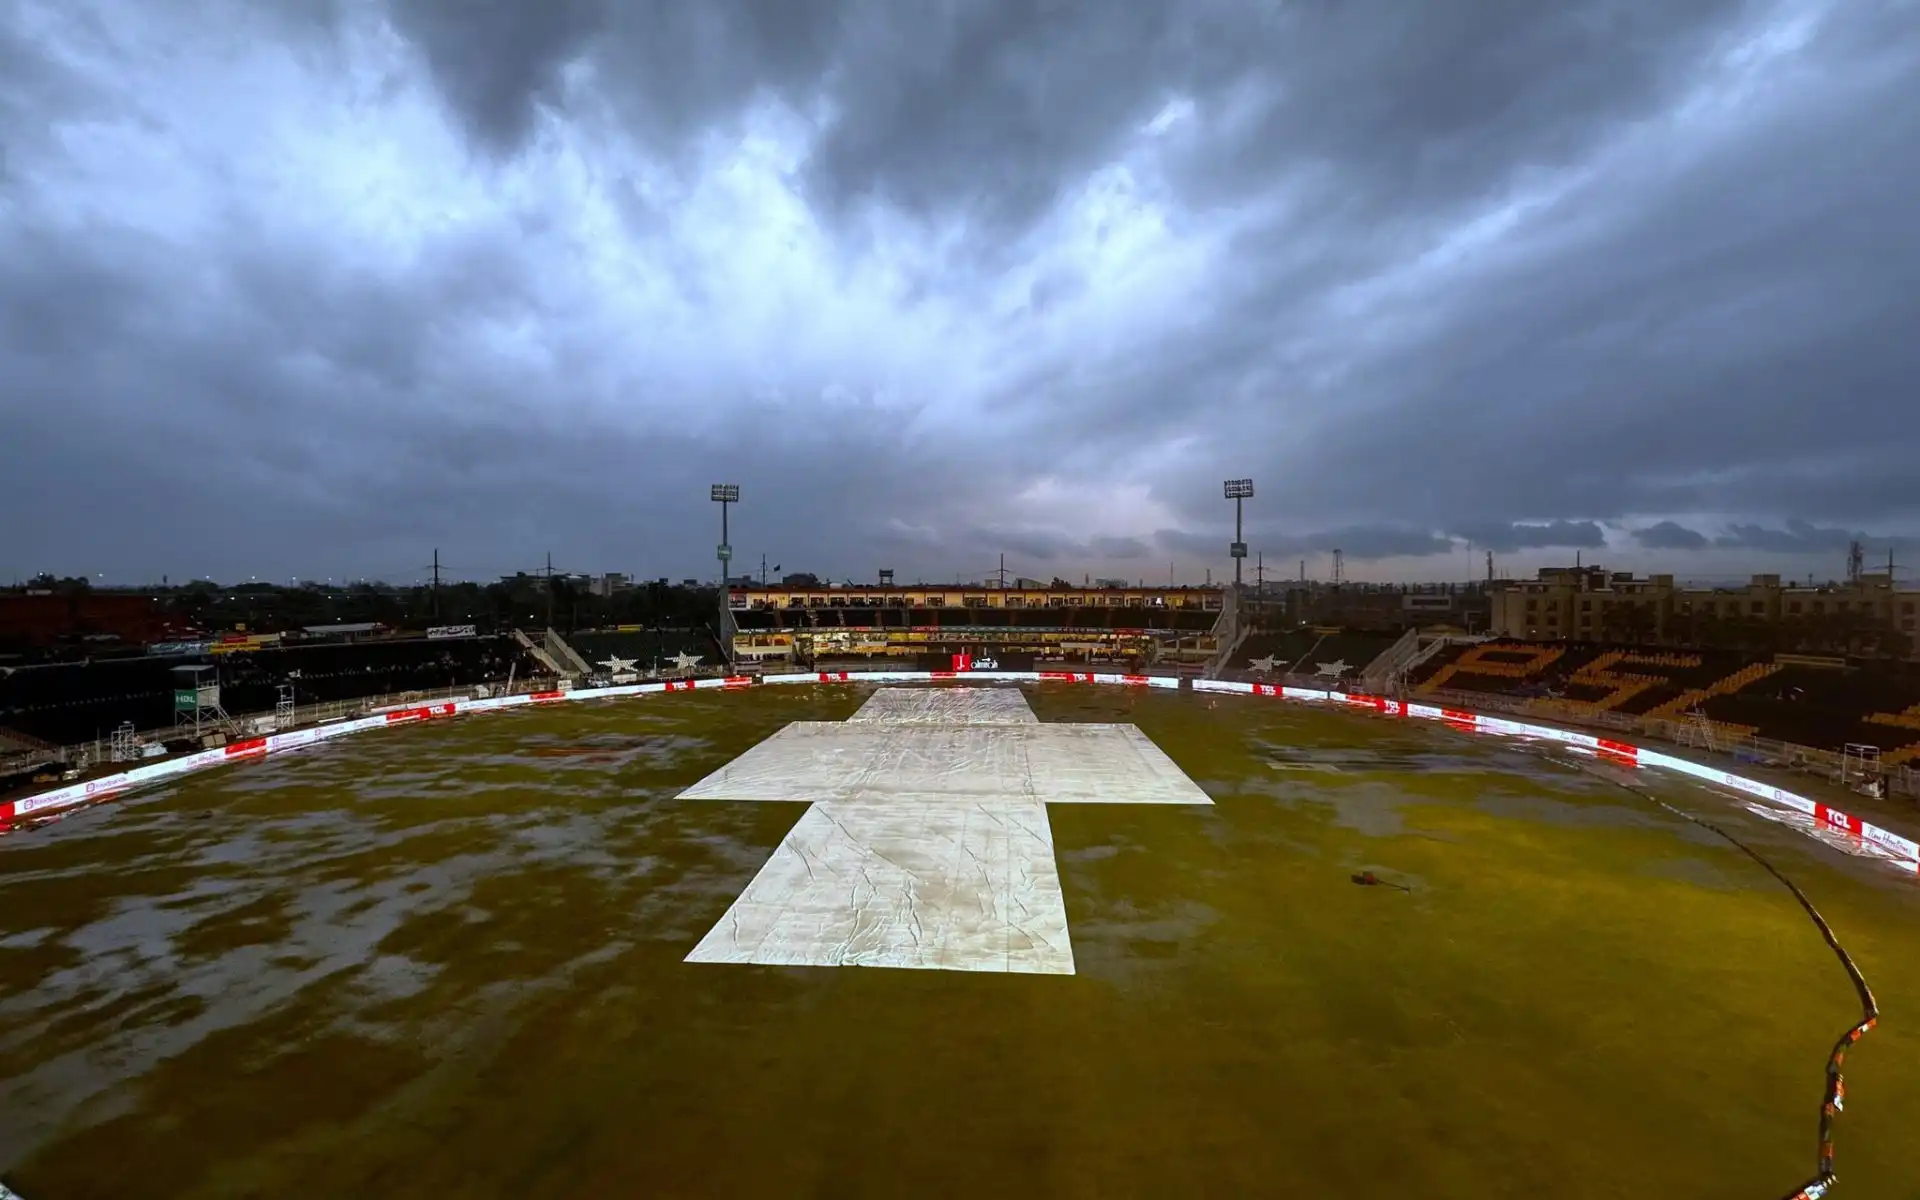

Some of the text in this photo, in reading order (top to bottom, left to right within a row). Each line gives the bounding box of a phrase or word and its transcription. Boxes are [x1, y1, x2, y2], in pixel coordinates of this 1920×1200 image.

[428, 704, 447, 714] TCL
[1383, 700, 1400, 709] TCL
[1826, 807, 1851, 829] TCL
